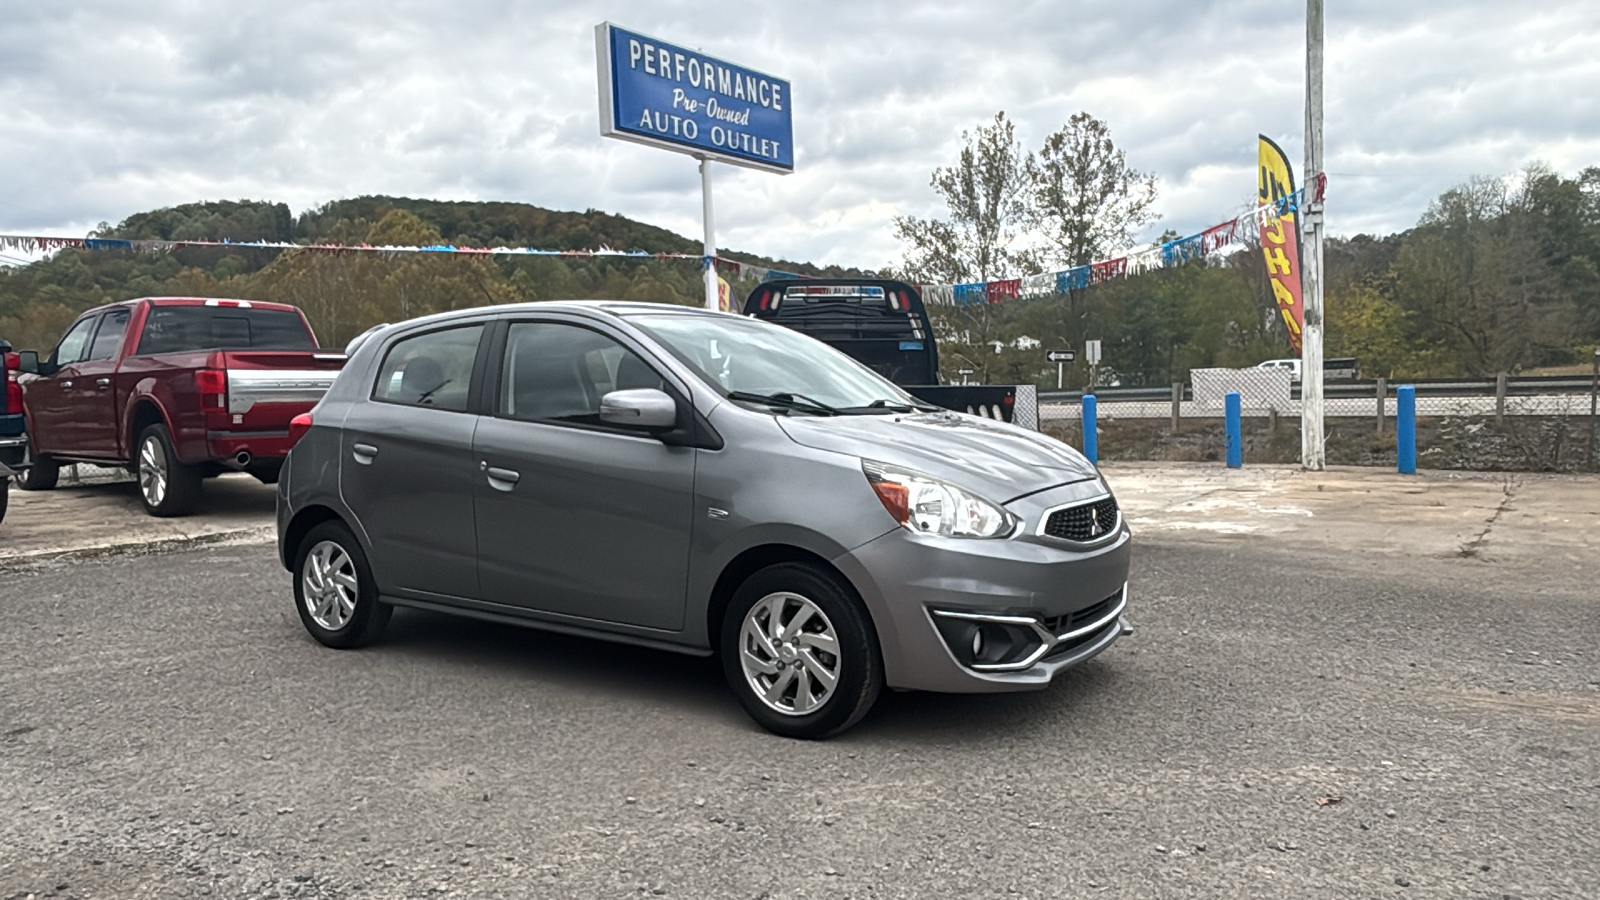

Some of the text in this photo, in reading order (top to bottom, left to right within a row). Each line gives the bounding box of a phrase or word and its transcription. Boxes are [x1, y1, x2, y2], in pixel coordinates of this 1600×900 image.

[629, 39, 782, 111] PERFORMANCE
[673, 88, 750, 126] Pre-Owned
[640, 109, 780, 159] AUTO OUTLET
